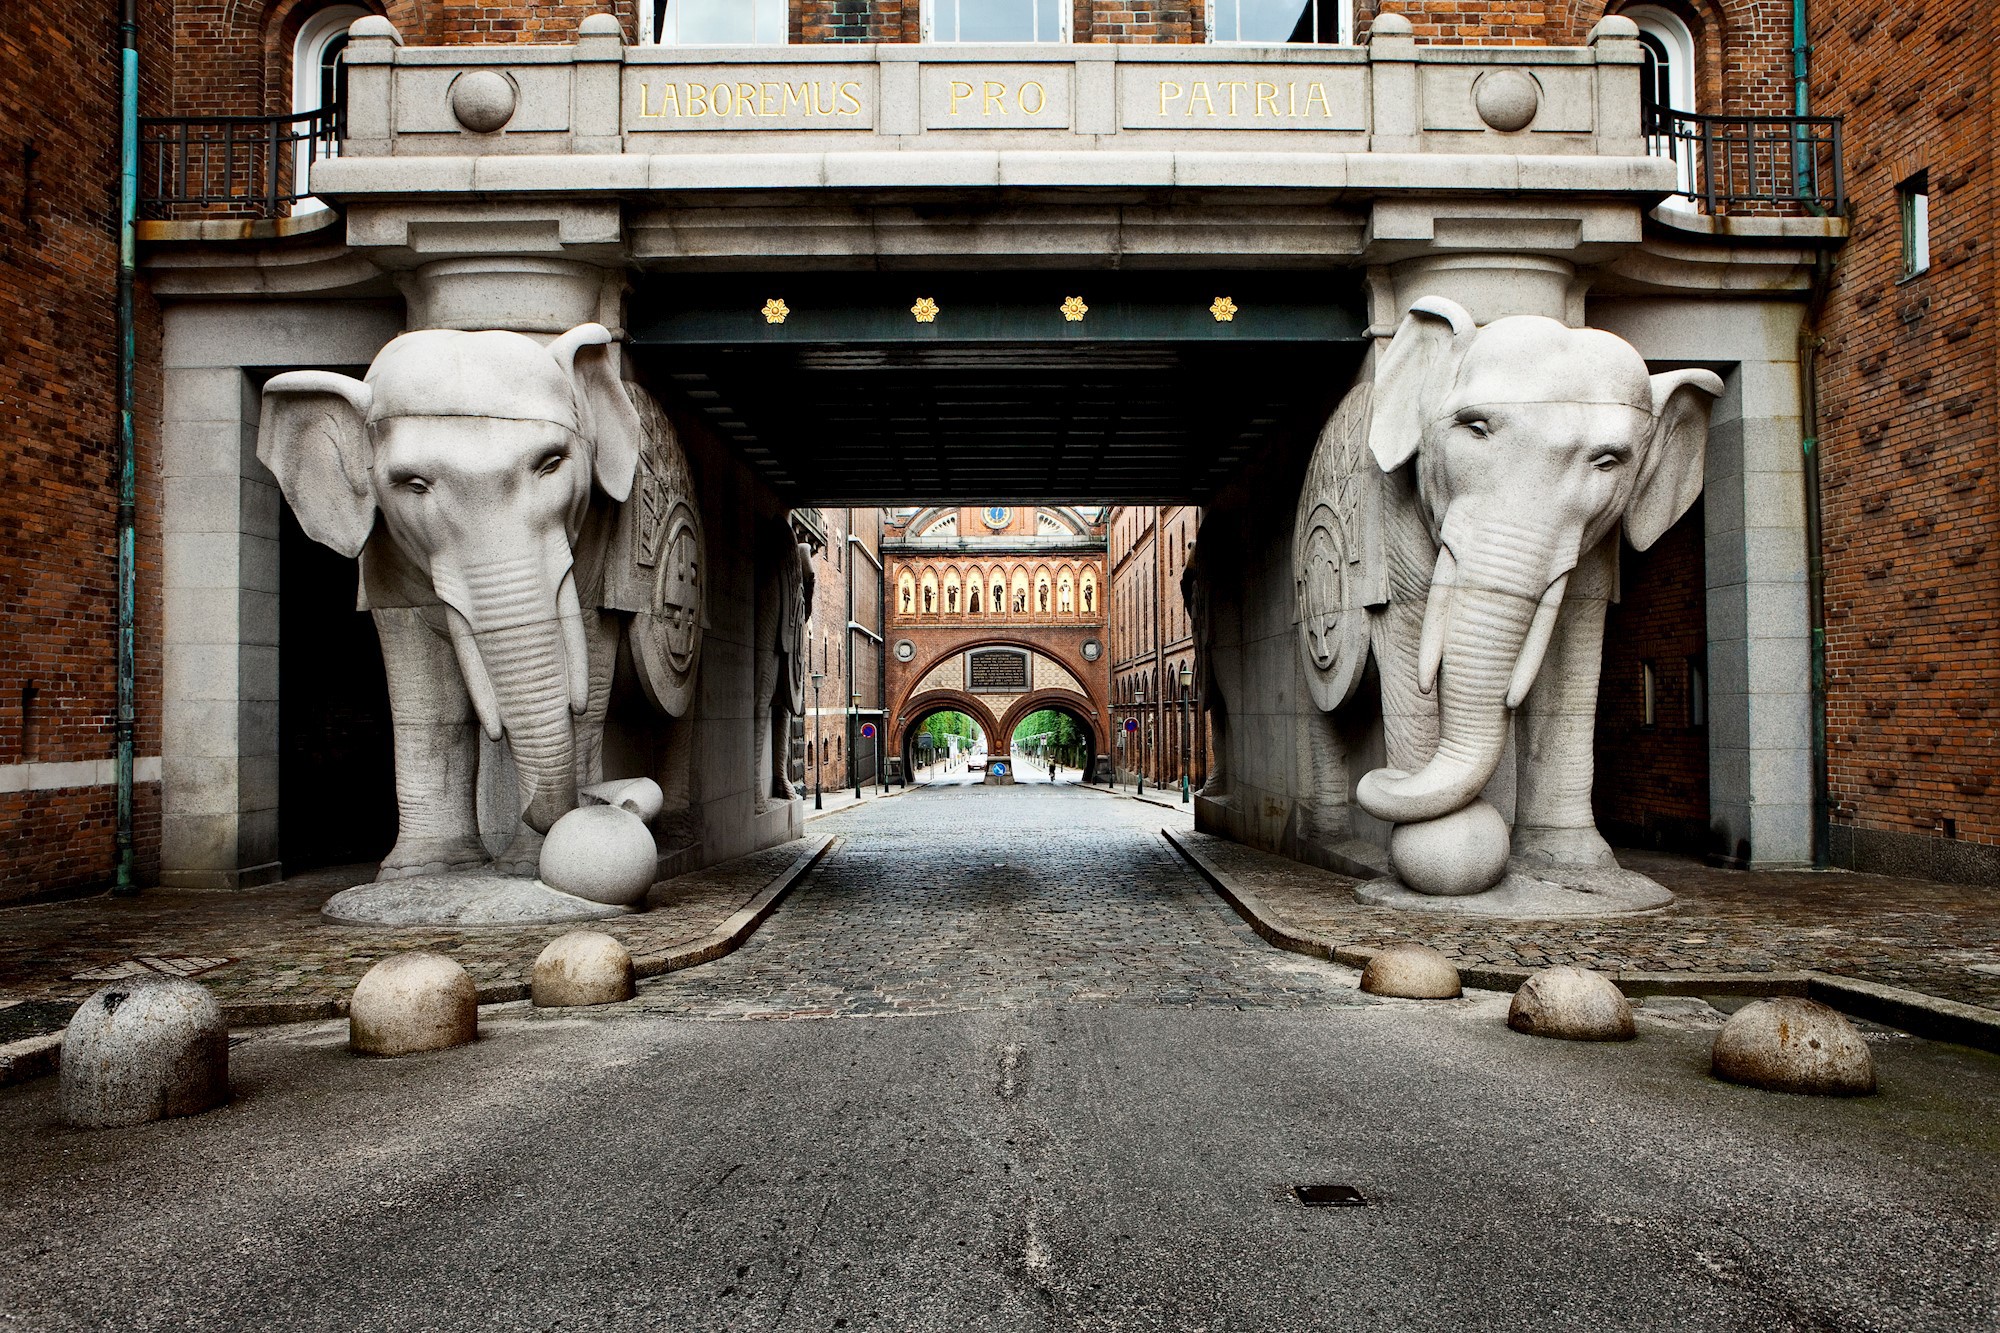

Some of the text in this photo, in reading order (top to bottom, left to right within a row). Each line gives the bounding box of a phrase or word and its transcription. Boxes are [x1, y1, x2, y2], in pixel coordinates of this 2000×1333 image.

[638, 80, 1333, 118] LABOREMUS PRO PATRIA
